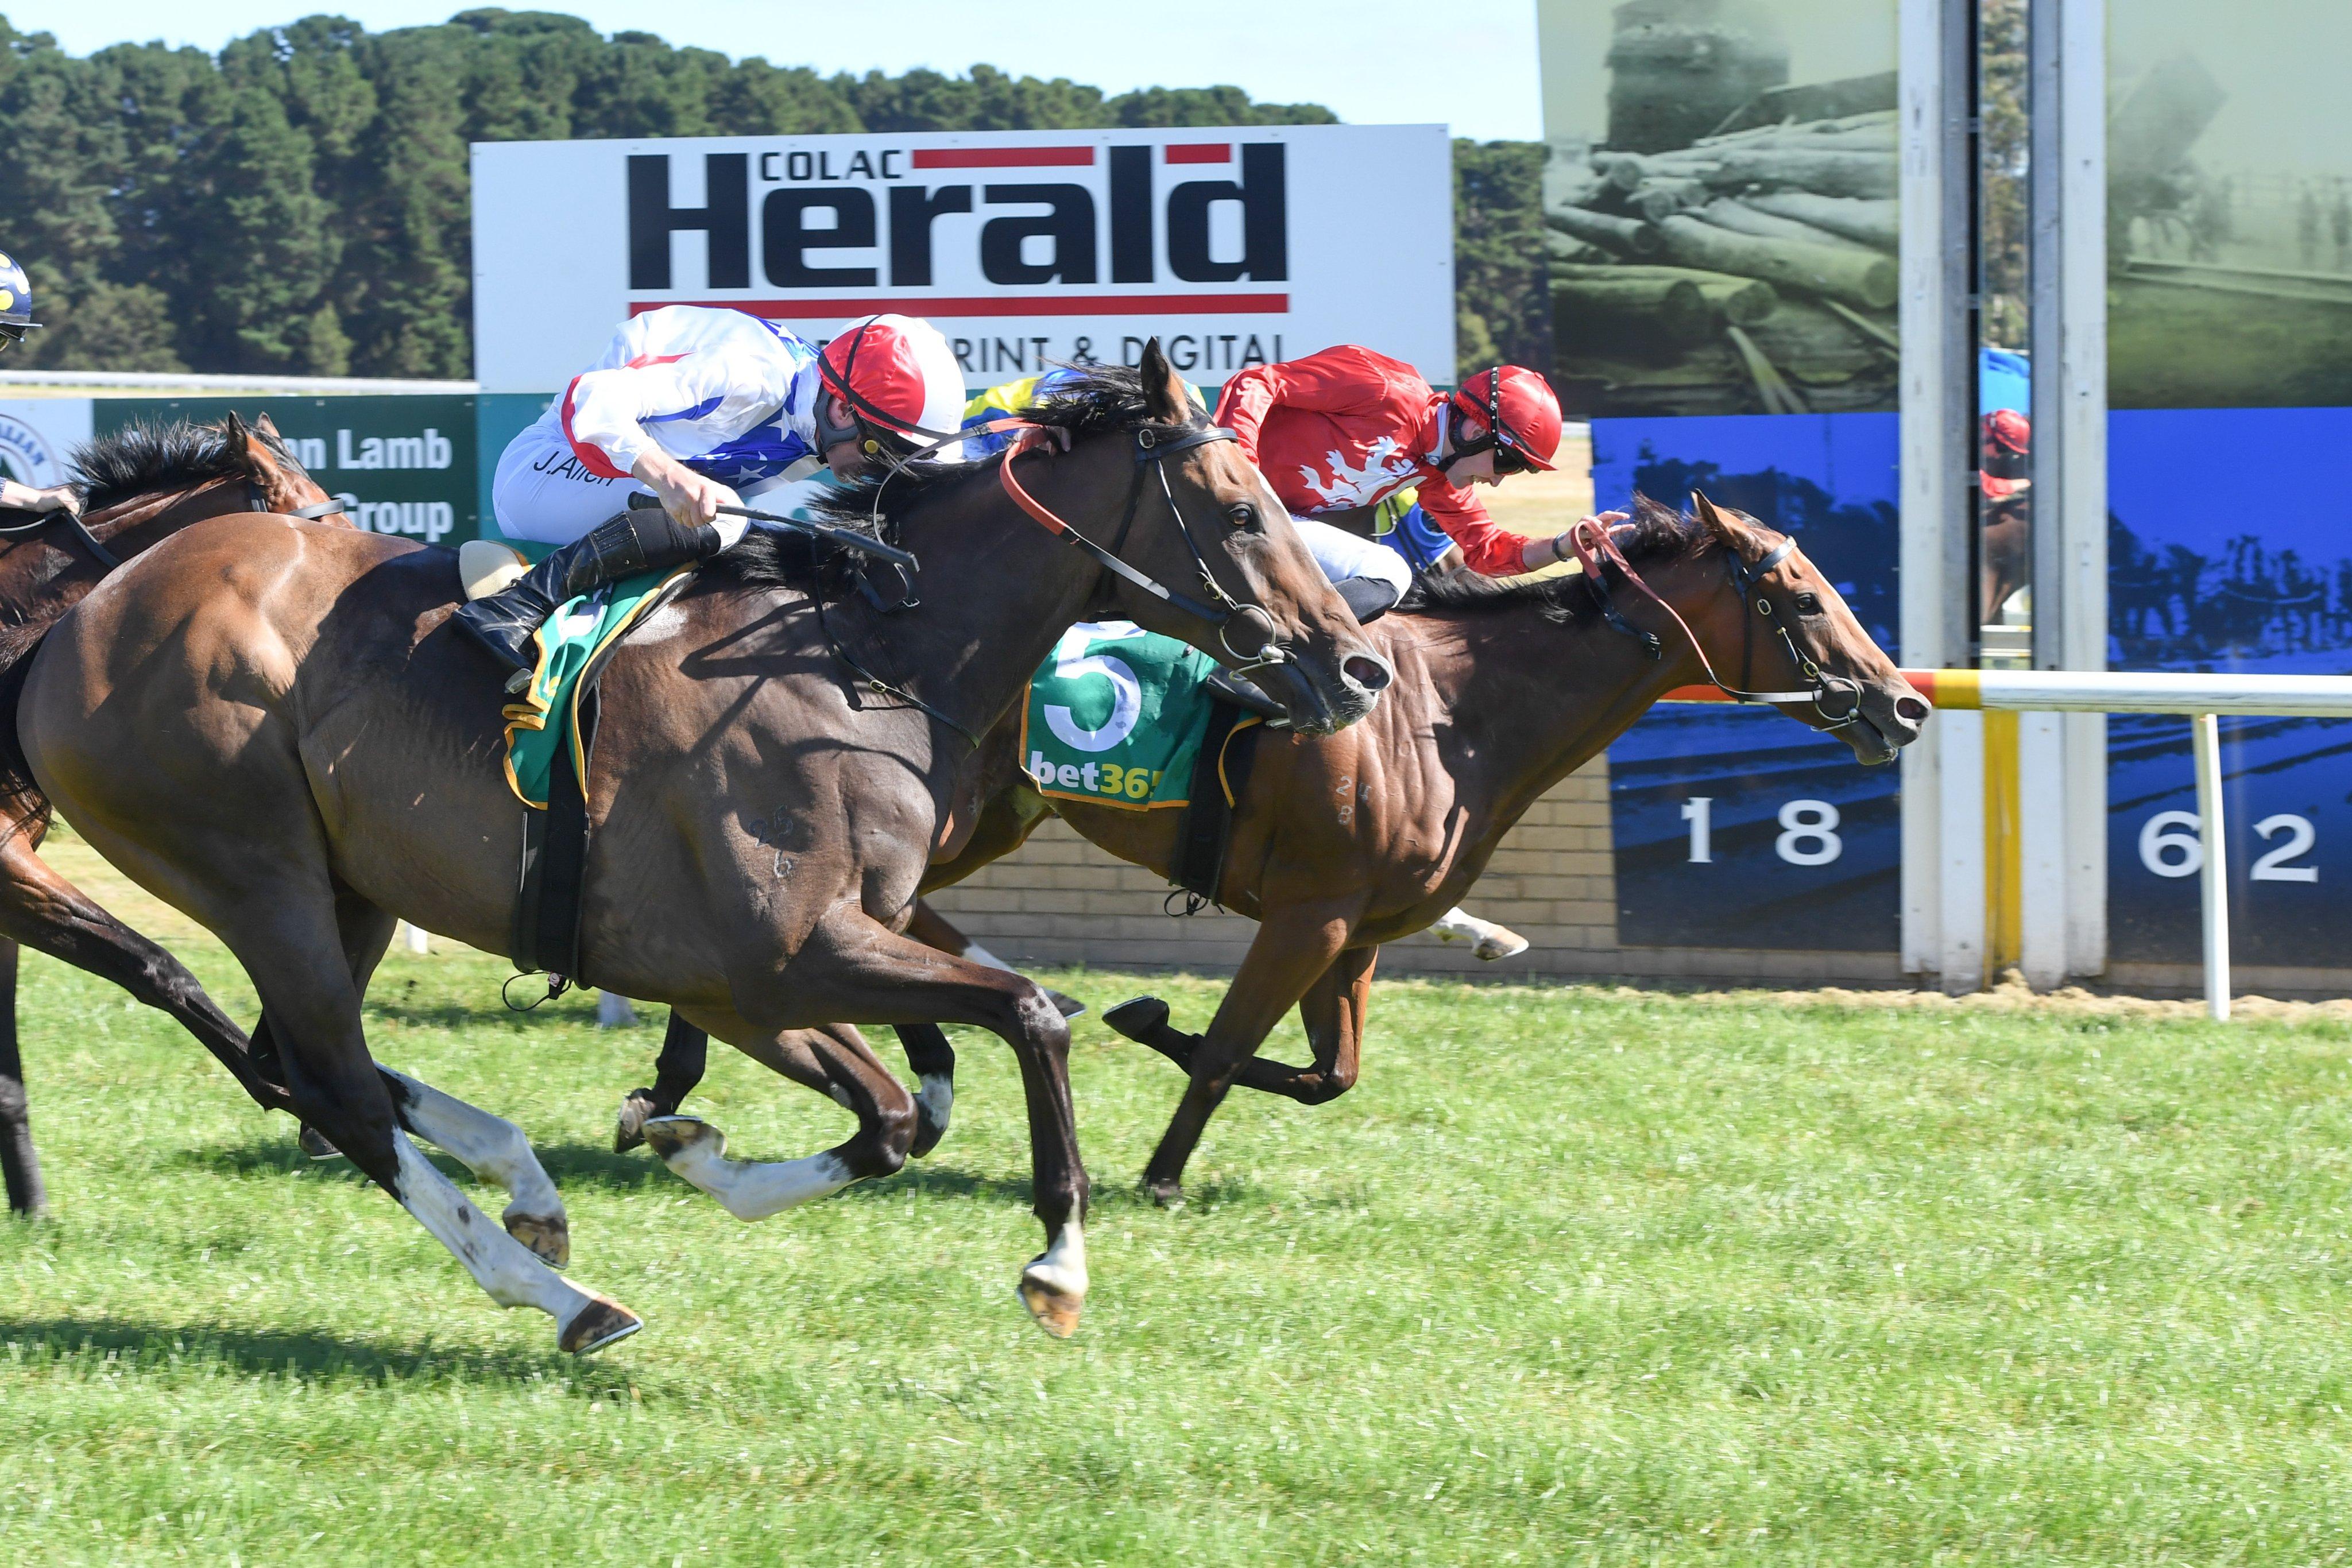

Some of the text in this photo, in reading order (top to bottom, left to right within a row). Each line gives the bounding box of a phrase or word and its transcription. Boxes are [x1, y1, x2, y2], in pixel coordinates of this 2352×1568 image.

[761, 150, 903, 181] COLAC
[626, 142, 1289, 290] Herald
[952, 336, 1050, 373] RINT
[1121, 334, 1282, 371] DGITAL
[337, 428, 453, 470] Lamb
[1043, 620, 1148, 753] 5
